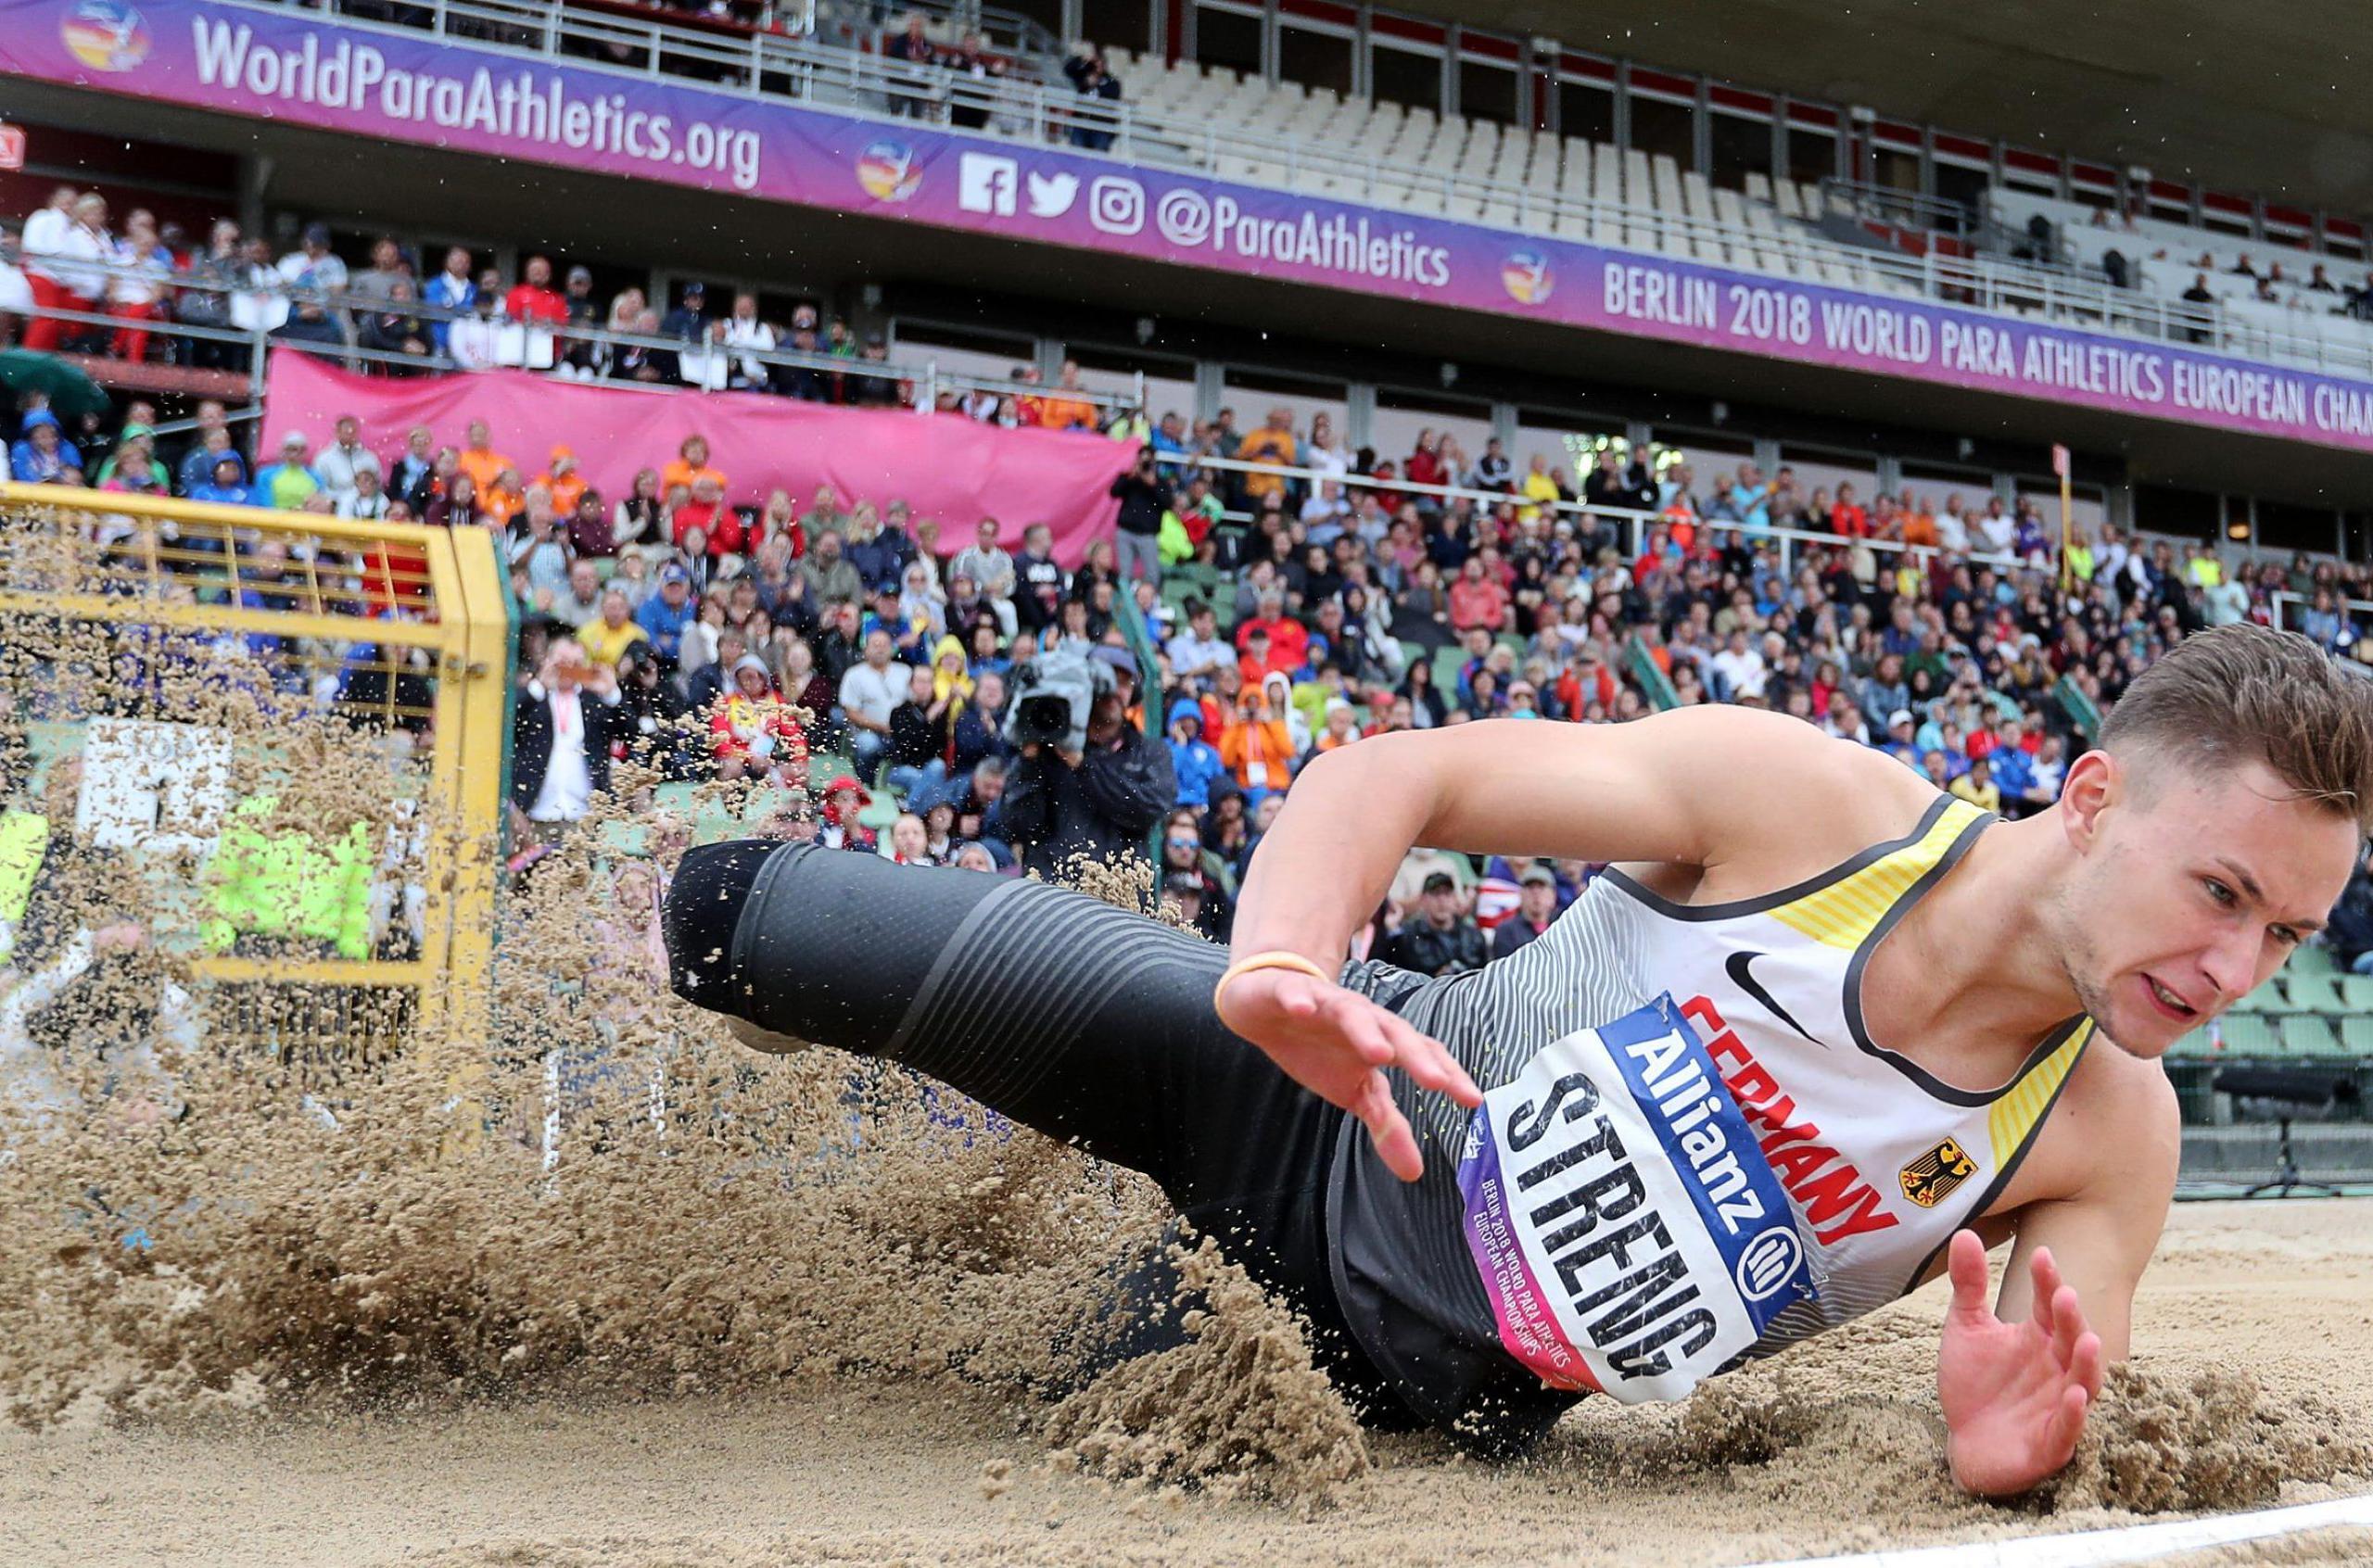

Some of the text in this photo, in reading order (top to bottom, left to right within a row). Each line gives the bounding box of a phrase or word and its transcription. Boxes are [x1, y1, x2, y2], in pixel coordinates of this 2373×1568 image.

[192, 14, 761, 190] WorldParaAthletics.org
[1157, 188, 1451, 289] @ParaAthletics
[1604, 261, 1717, 330] BERLIN
[1729, 288, 1811, 346] 2018
[1821, 300, 1931, 364] WORLD
[1940, 321, 2014, 378] PARA
[2023, 336, 2164, 403] ATHLETICS
[2173, 359, 2306, 426] EUROPEAN
[1482, 1178, 1502, 1219] BERLIN
[1625, 1028, 1765, 1235] Allianz
[1473, 1211, 1542, 1356] EUROPEAN CHAMPIONSHIPS
[1491, 1218, 1511, 1249] 2018
[1507, 1072, 1717, 1381] STRENG
[1516, 1290, 1541, 1321] PARA
